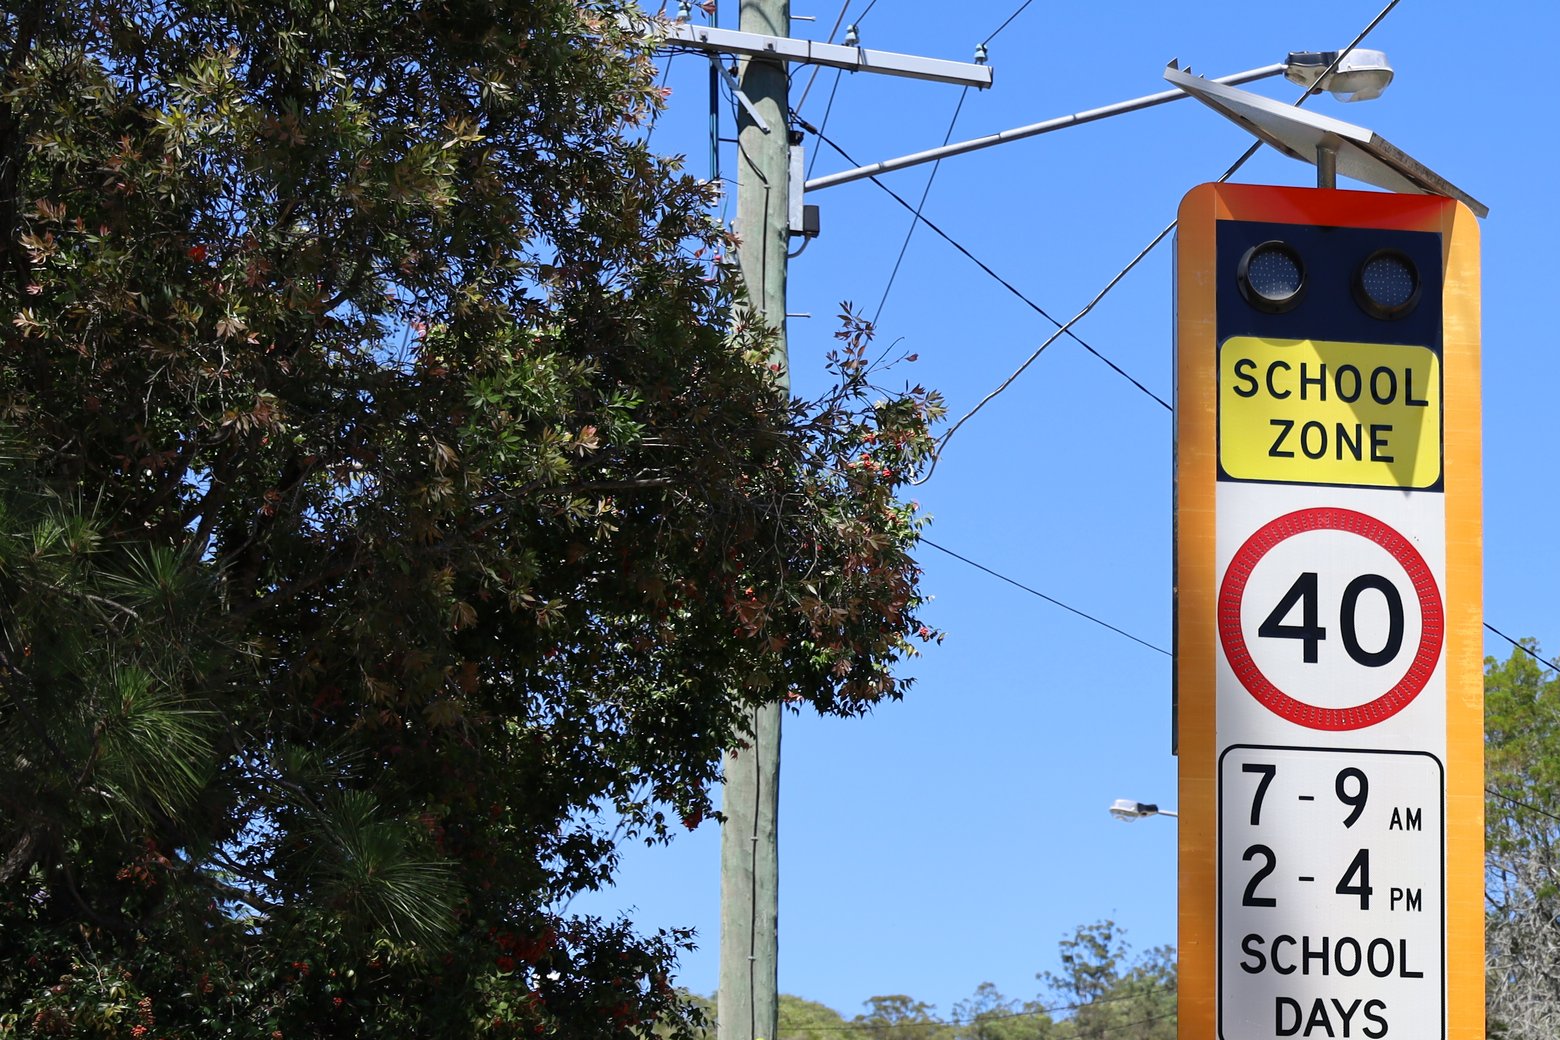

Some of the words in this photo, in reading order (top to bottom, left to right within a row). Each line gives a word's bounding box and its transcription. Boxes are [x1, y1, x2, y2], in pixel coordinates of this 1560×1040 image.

[1232, 358, 1429, 407] SCHOOL
[1268, 419, 1394, 463] ZONE
[1258, 572, 1404, 668] 40
[1389, 807, 1422, 831] AM
[1390, 888, 1422, 912] PM
[1239, 933, 1424, 979] SCHOOL
[1275, 996, 1389, 1040] DAYS
